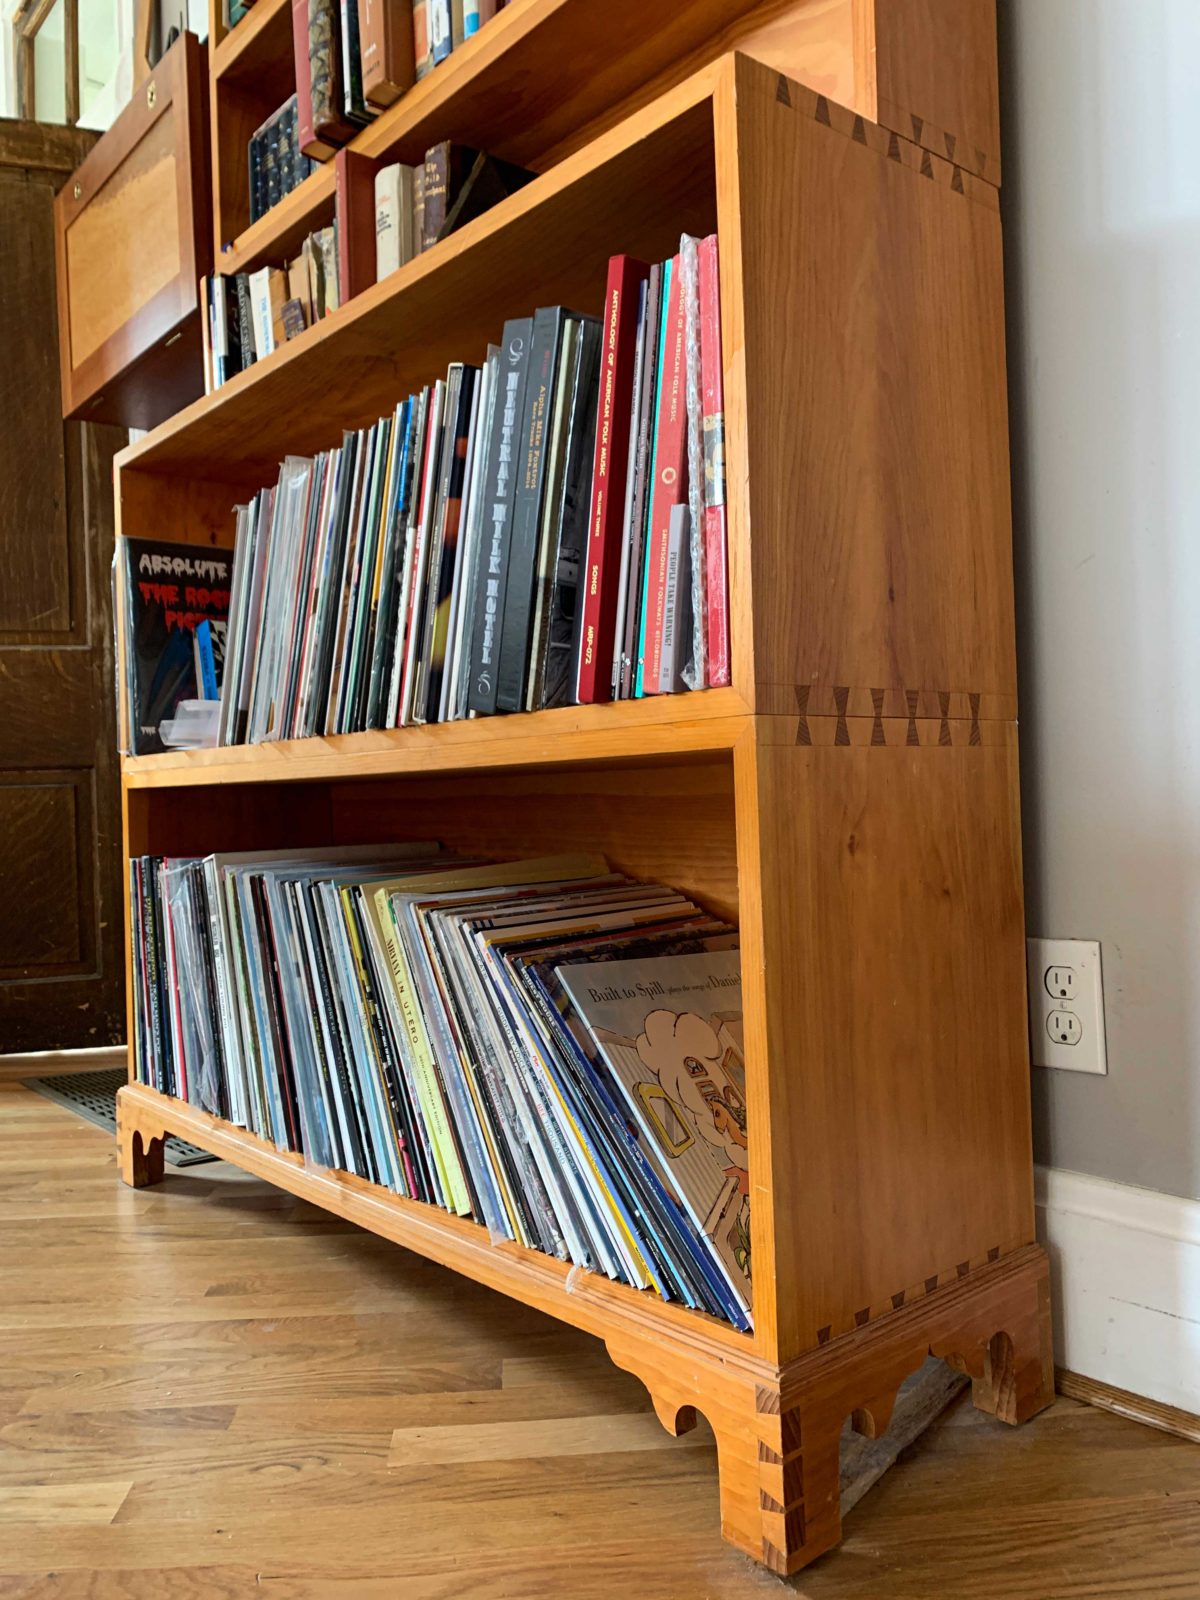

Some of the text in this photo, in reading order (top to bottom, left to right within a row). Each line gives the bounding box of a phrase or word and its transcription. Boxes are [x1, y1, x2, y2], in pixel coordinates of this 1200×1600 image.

[607, 289, 618, 349] ANTHOLOGY
[606, 352, 614, 366] OF
[672, 332, 682, 373] AMERICAN
[603, 368, 613, 418] AMERICAN
[669, 397, 677, 422] MUSIC
[529, 384, 547, 490] Alpha Mike Foxtrot
[600, 420, 609, 445] FOLK
[598, 447, 607, 477] MUSIC
[480, 371, 519, 664] NEUTRAL MILK HOTEL
[139, 553, 228, 583] ABSOLUTE
[657, 528, 668, 582] SMITHSONIAN
[138, 582, 178, 607] THE
[589, 564, 598, 595] SONGS
[663, 551, 677, 646] PEOPLE TAKE WARNING!
[655, 586, 663, 626] FOLKWAYS
[584, 625, 594, 664] MRP-072
[381, 938, 403, 976] NIRVANA
[400, 1001, 421, 1044] UTERO
[586, 986, 622, 1002] Built
[622, 987, 636, 999] to
[636, 981, 665, 1000] Spill
[496, 1005, 512, 1035] GUIDED
[508, 1035, 516, 1046] BY
[512, 1047, 529, 1075] VOICES
[536, 1102, 546, 1117] BEE
[543, 1119, 566, 1164] THOUSAND
